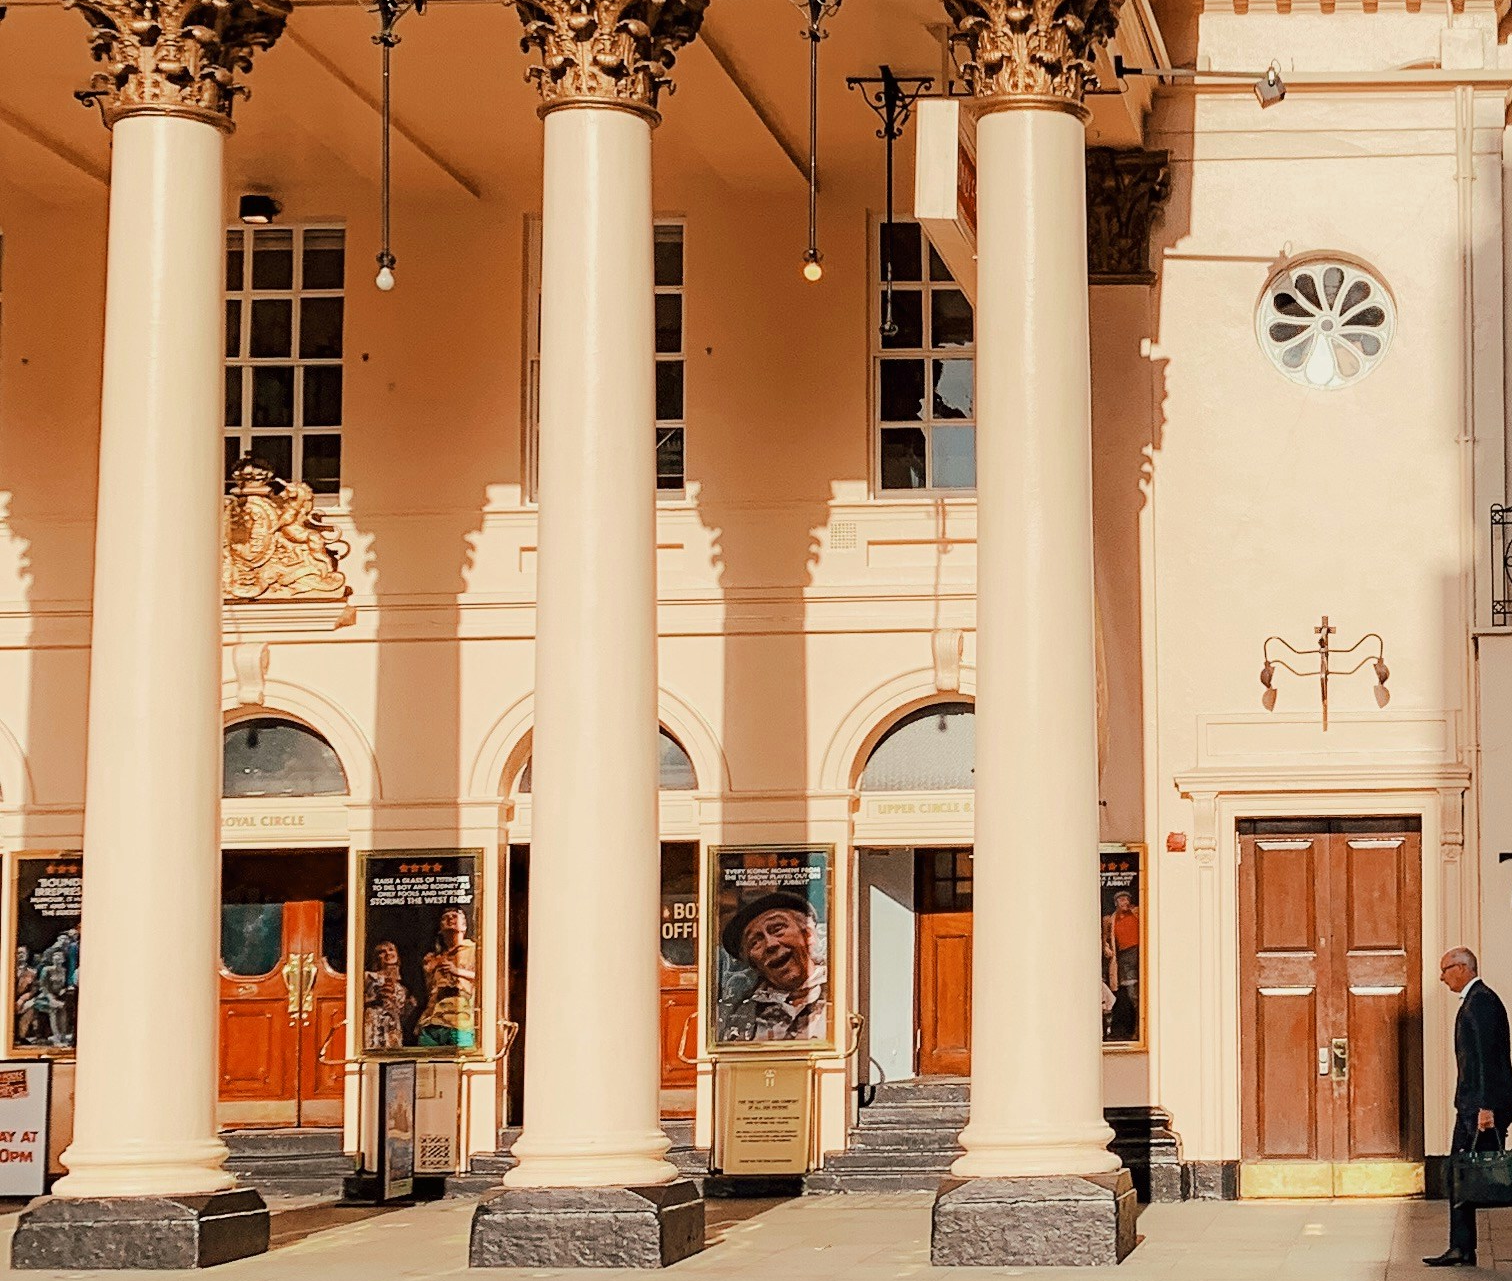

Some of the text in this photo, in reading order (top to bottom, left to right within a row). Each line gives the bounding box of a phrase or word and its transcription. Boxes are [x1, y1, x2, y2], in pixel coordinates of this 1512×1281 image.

[878, 803, 916, 815] UPPER
[918, 802, 961, 814] CIRCLE
[260, 814, 305, 827] CIRCLE
[20, 1131, 39, 1143] AT
